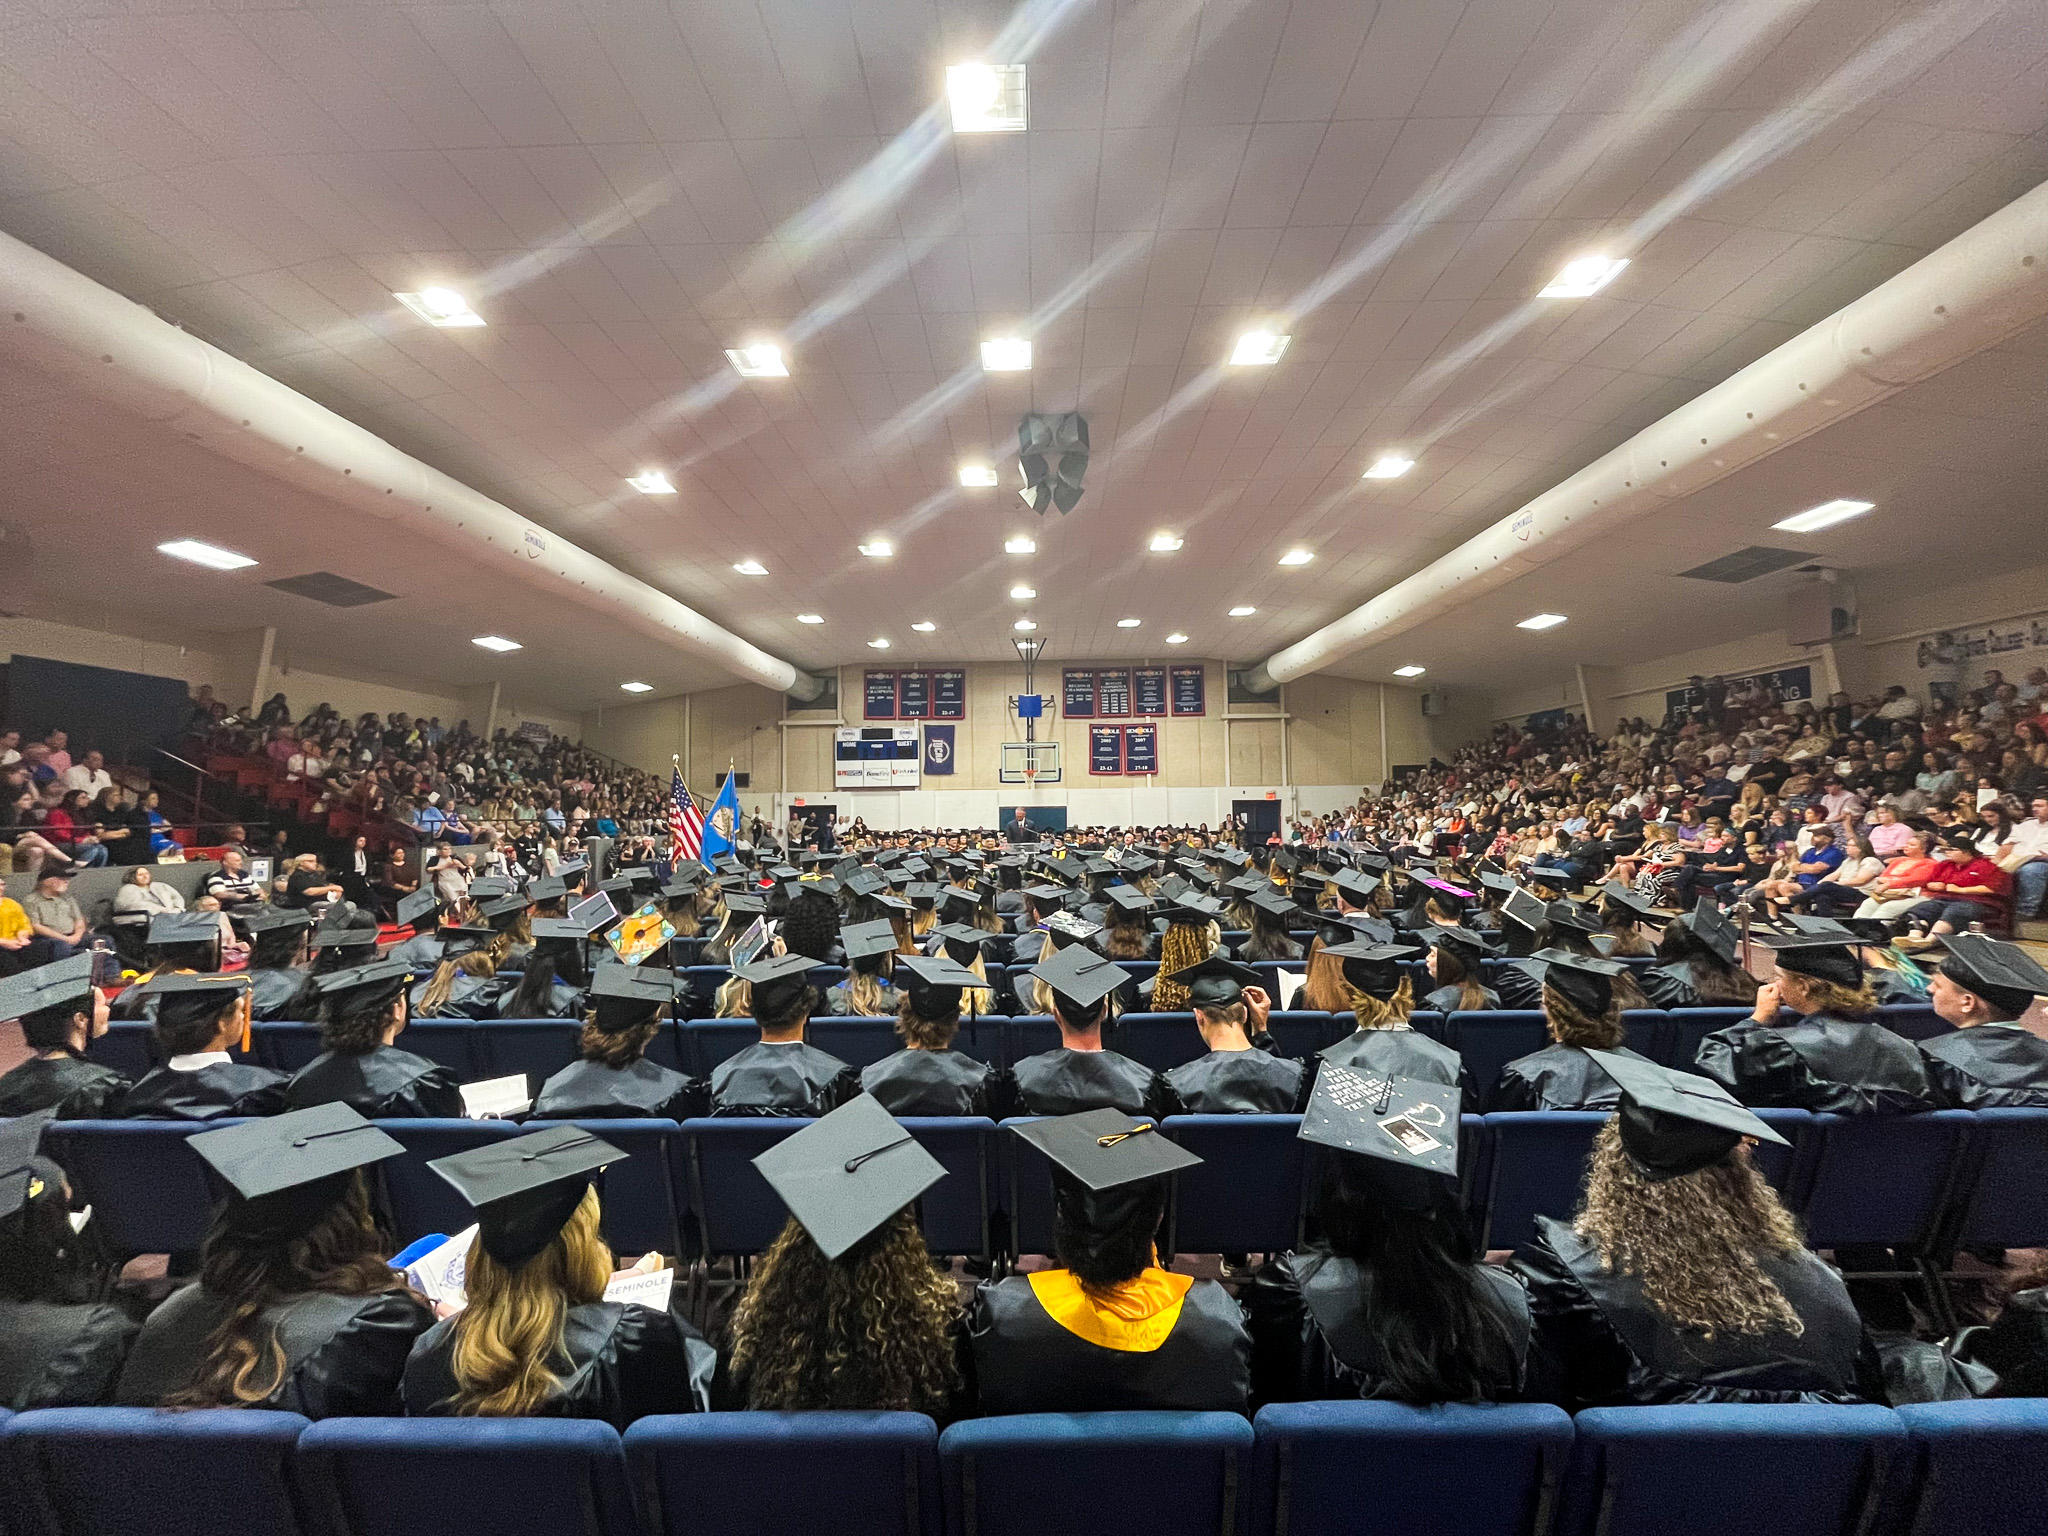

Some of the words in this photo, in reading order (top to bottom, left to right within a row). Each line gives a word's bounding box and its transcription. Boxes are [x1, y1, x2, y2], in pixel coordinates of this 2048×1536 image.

[1322, 1067, 1347, 1078] HOPE
[1326, 1080, 1353, 1093] PROUD
[1352, 1077, 1366, 1085] OF
[1343, 1101, 1365, 1112] THE
[607, 1276, 668, 1297] SEMINOLE
